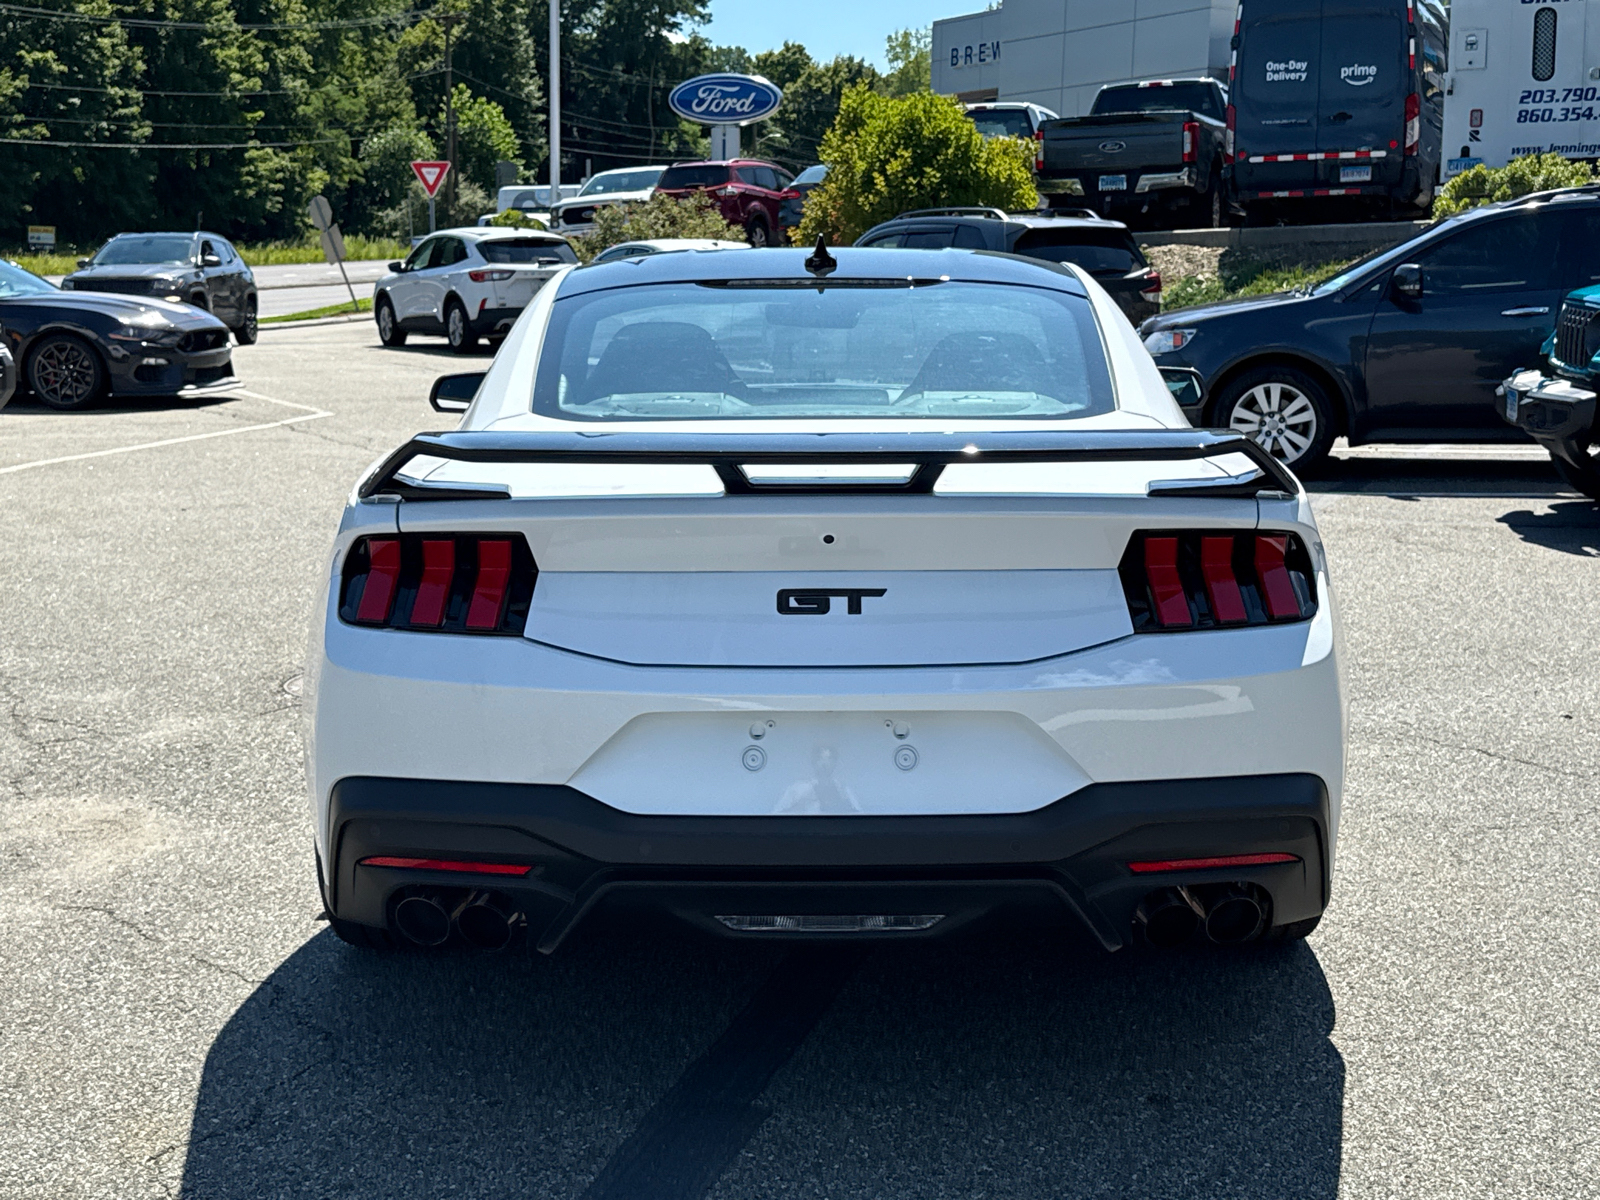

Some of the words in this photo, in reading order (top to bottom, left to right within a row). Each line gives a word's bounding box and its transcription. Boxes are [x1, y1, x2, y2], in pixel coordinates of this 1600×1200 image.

[951, 41, 1001, 67] BREW
[1266, 60, 1308, 71] One-Day
[1341, 64, 1377, 79] prime
[1266, 71, 1308, 81] Delivery
[692, 85, 756, 113] Ford
[1516, 106, 1600, 123] 860.354.
[776, 588, 888, 615] GT
